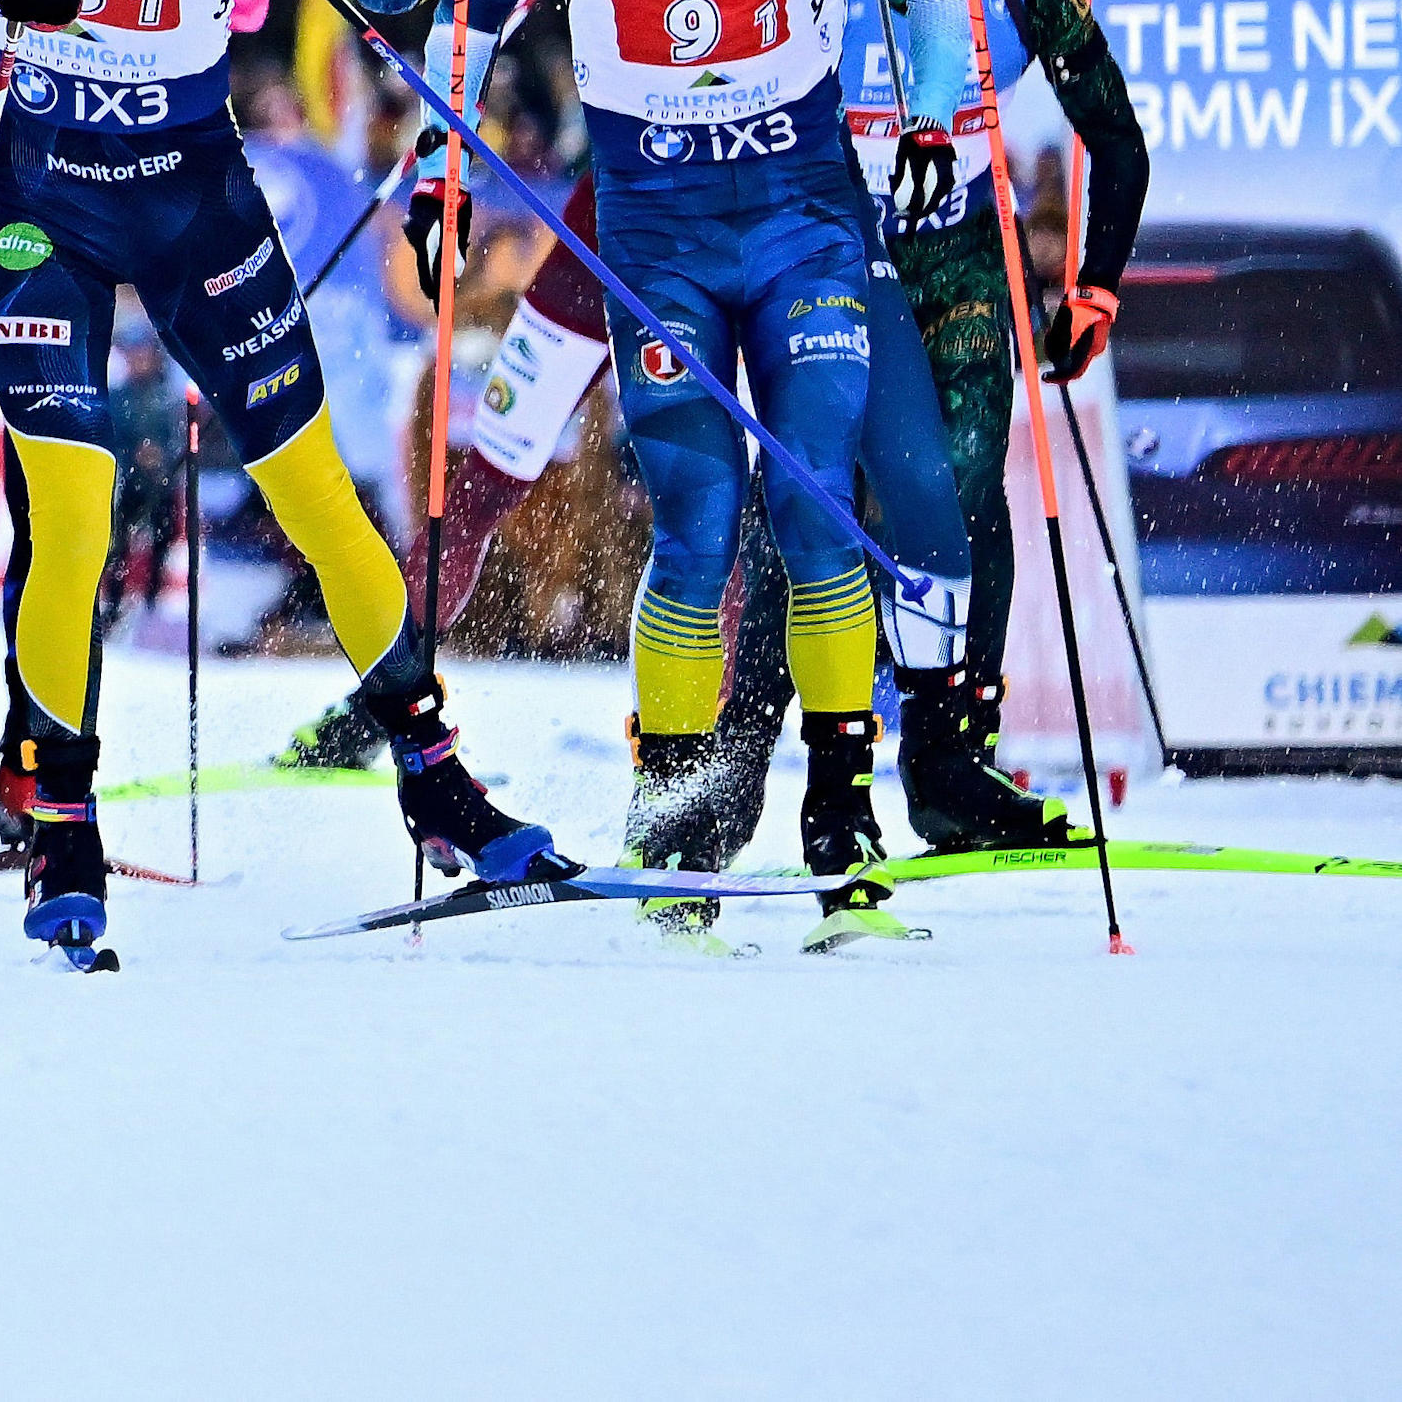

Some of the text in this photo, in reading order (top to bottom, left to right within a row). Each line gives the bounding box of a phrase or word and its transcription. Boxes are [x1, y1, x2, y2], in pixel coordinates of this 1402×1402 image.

[1106, 1, 1402, 73] THE NE
[74, 81, 169, 126] iX3
[646, 77, 779, 106] CHIEMGAU
[709, 111, 797, 161] iX3
[47, 151, 183, 182] Monitor ERP
[250, 364, 301, 402] ATG
[993, 850, 1068, 866] FISCHER
[486, 883, 556, 910] SALOMON
